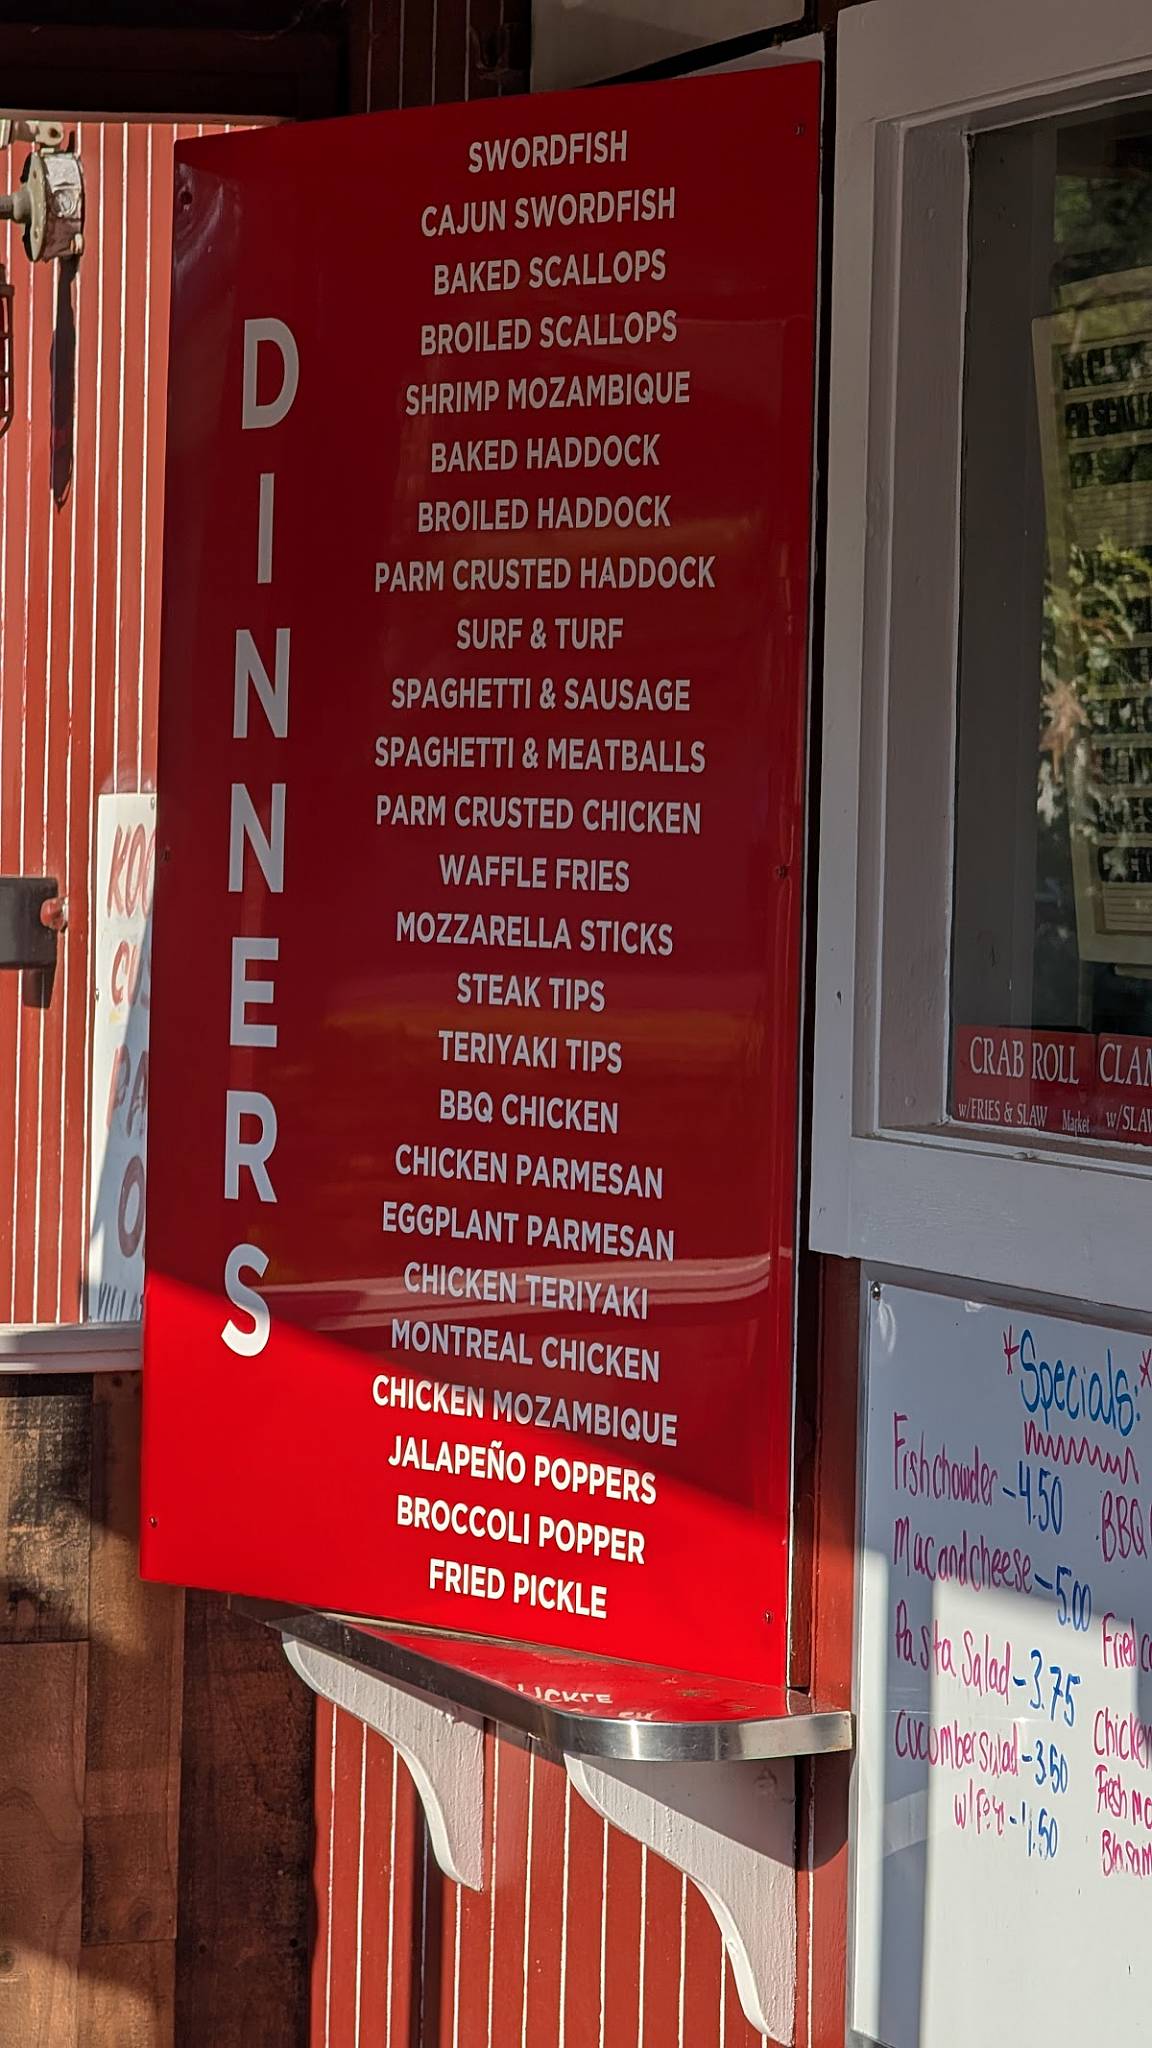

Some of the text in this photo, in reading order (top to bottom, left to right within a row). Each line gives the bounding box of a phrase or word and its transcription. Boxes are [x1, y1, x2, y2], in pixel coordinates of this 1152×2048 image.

[469, 131, 626, 172] SWORDFISH
[422, 188, 674, 236] CAJUN SWORDFISH
[435, 249, 665, 294] BAKED SCALLOPS
[422, 310, 676, 355] BROILED SCALLOPS
[406, 372, 689, 414] SHRIMP MOZAMBIQUE
[432, 434, 659, 472] BAKED HADDOCK
[419, 496, 670, 532] BROILED HADDOCK
[376, 557, 714, 592] PARM CRUSTED HADDOCK
[457, 619, 623, 649] SURF & TURF
[392, 678, 689, 710] SPAGHETTI & SAUSAGE
[376, 737, 705, 772] SPAGHETTI & MEATBALLS
[377, 795, 700, 833] PARM CRUSTED CHICKEN
[221, 317, 299, 1356] DINNERS
[440, 855, 629, 892] WAFFLE FRIES
[397, 912, 672, 955] MOZZARELLA STICKS
[457, 973, 604, 1012] STEAK TIPS
[439, 1031, 621, 1073] TERIYAKI TIPS
[970, 1036, 1079, 1085] CRAB ROLL
[441, 1090, 617, 1133] BBQ CHICKEN
[958, 1097, 1048, 1127] w/FRIES & SLAW
[1062, 1109, 1090, 1136] Market
[396, 1144, 662, 1199] CHICKEN PARMESAN
[383, 1202, 673, 1262] EGGPLANT PARMESAN
[404, 1261, 648, 1320] CHICKEN TERIYAKI
[392, 1318, 659, 1382] MONTREAL CHICKEN
[373, 1375, 677, 1446] CHICKEN MOZAMBIQUE
[388, 1436, 656, 1504] JALAPEÑO POPPERS
[398, 1495, 644, 1564] BROCCOLI POPPER
[1101, 1490, 1148, 1563] BBQ
[430, 1558, 607, 1618] FRIED PICKLE
[1102, 1613, 1137, 1668] Fried
